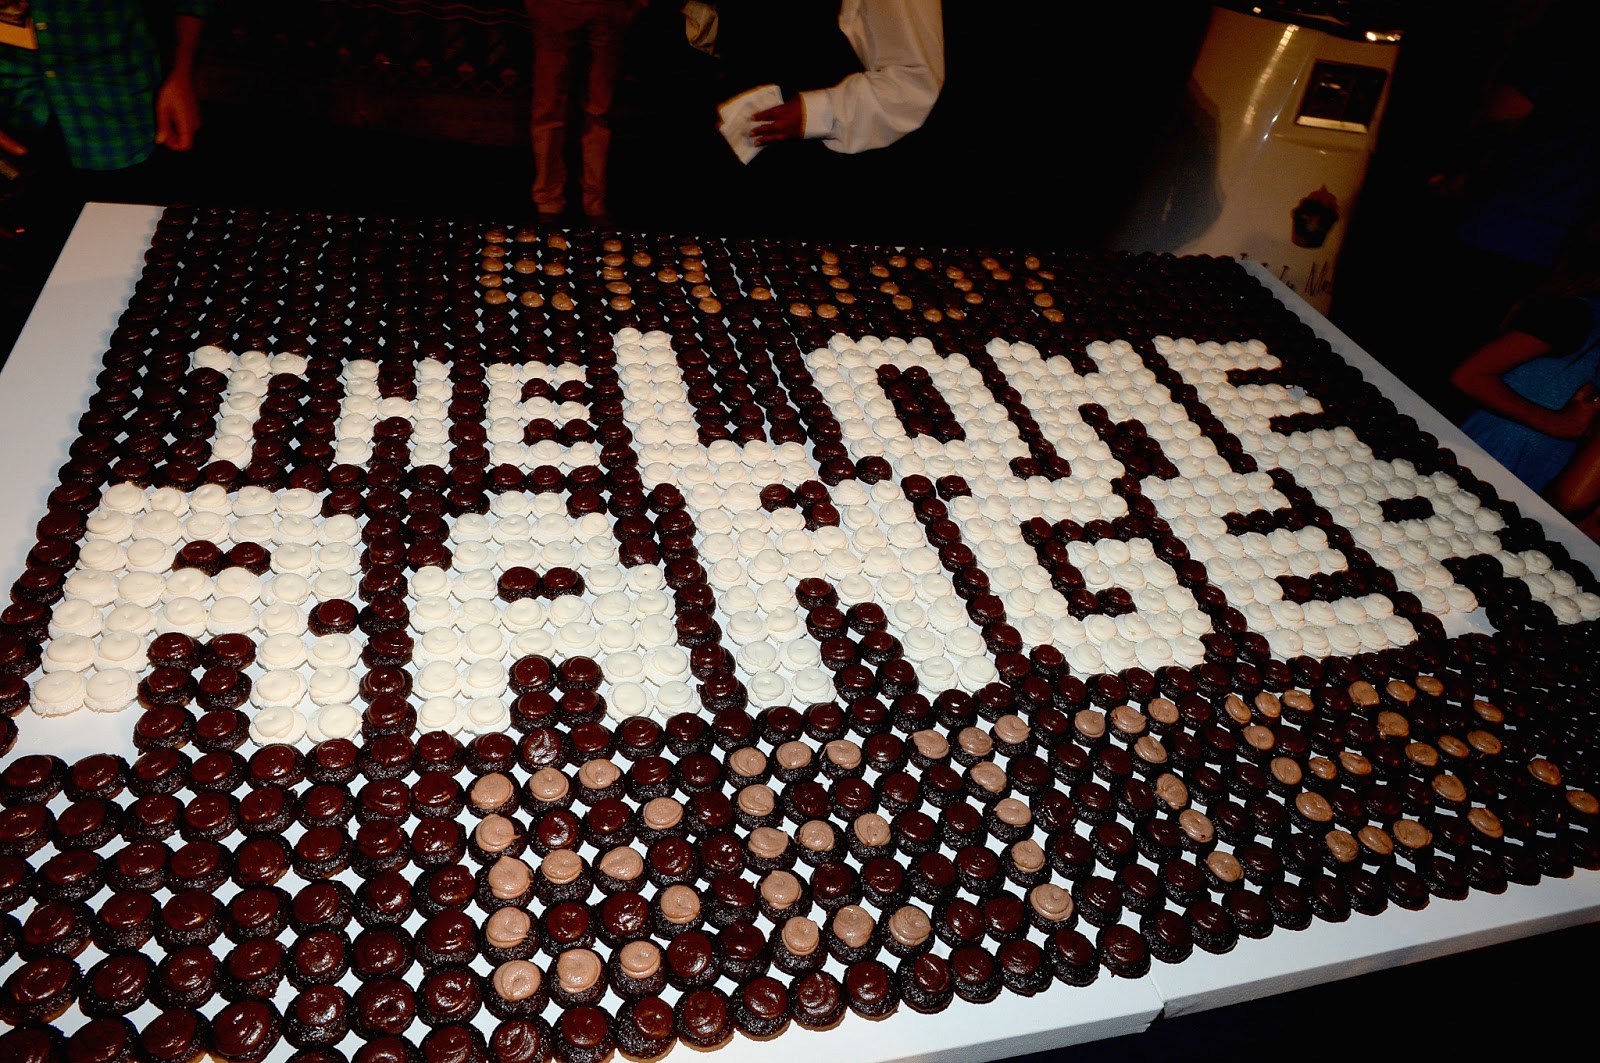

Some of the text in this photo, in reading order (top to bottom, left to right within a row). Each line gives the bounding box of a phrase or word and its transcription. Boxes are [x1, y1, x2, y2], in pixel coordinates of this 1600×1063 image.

[482, 229, 1055, 323] ENJOY
[193, 327, 1374, 490] THE LONE
[30, 458, 1600, 752] RANGER
[470, 672, 1600, 1003] BETTER
